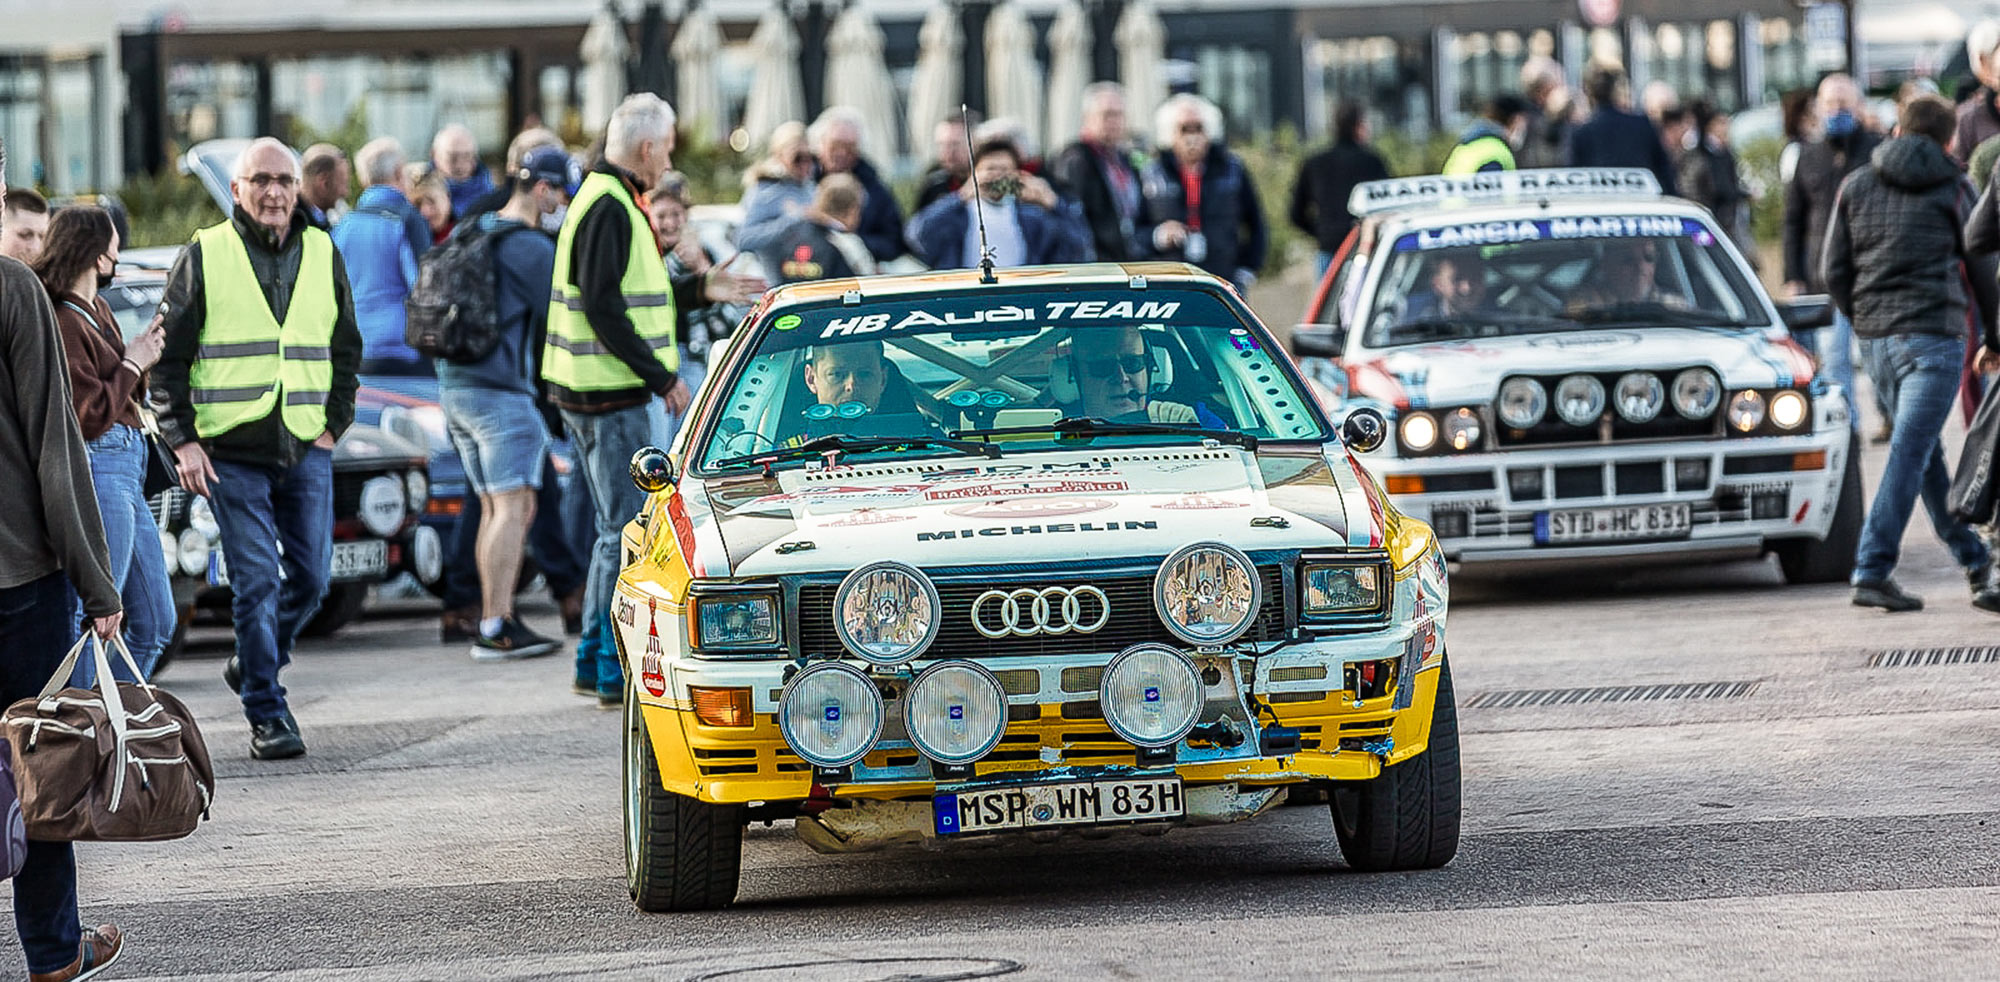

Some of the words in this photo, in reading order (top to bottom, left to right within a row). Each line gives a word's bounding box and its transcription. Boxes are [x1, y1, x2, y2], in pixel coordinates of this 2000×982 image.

[1367, 176, 1503, 200] MARTINI
[1520, 172, 1647, 188] RACING
[1418, 221, 1540, 250] LANCIA
[1551, 216, 1682, 239] MARTINI
[819, 313, 891, 339] HB
[1045, 302, 1181, 320] TEAM
[917, 521, 1158, 542] MICHELIN
[1553, 511, 1595, 535] STD
[1613, 508, 1641, 532] HC
[1648, 503, 1690, 530] 831
[617, 595, 636, 628] Castrol
[959, 792, 1027, 828] MSP
[1056, 786, 1102, 819] WM
[1112, 783, 1181, 815] 83H
